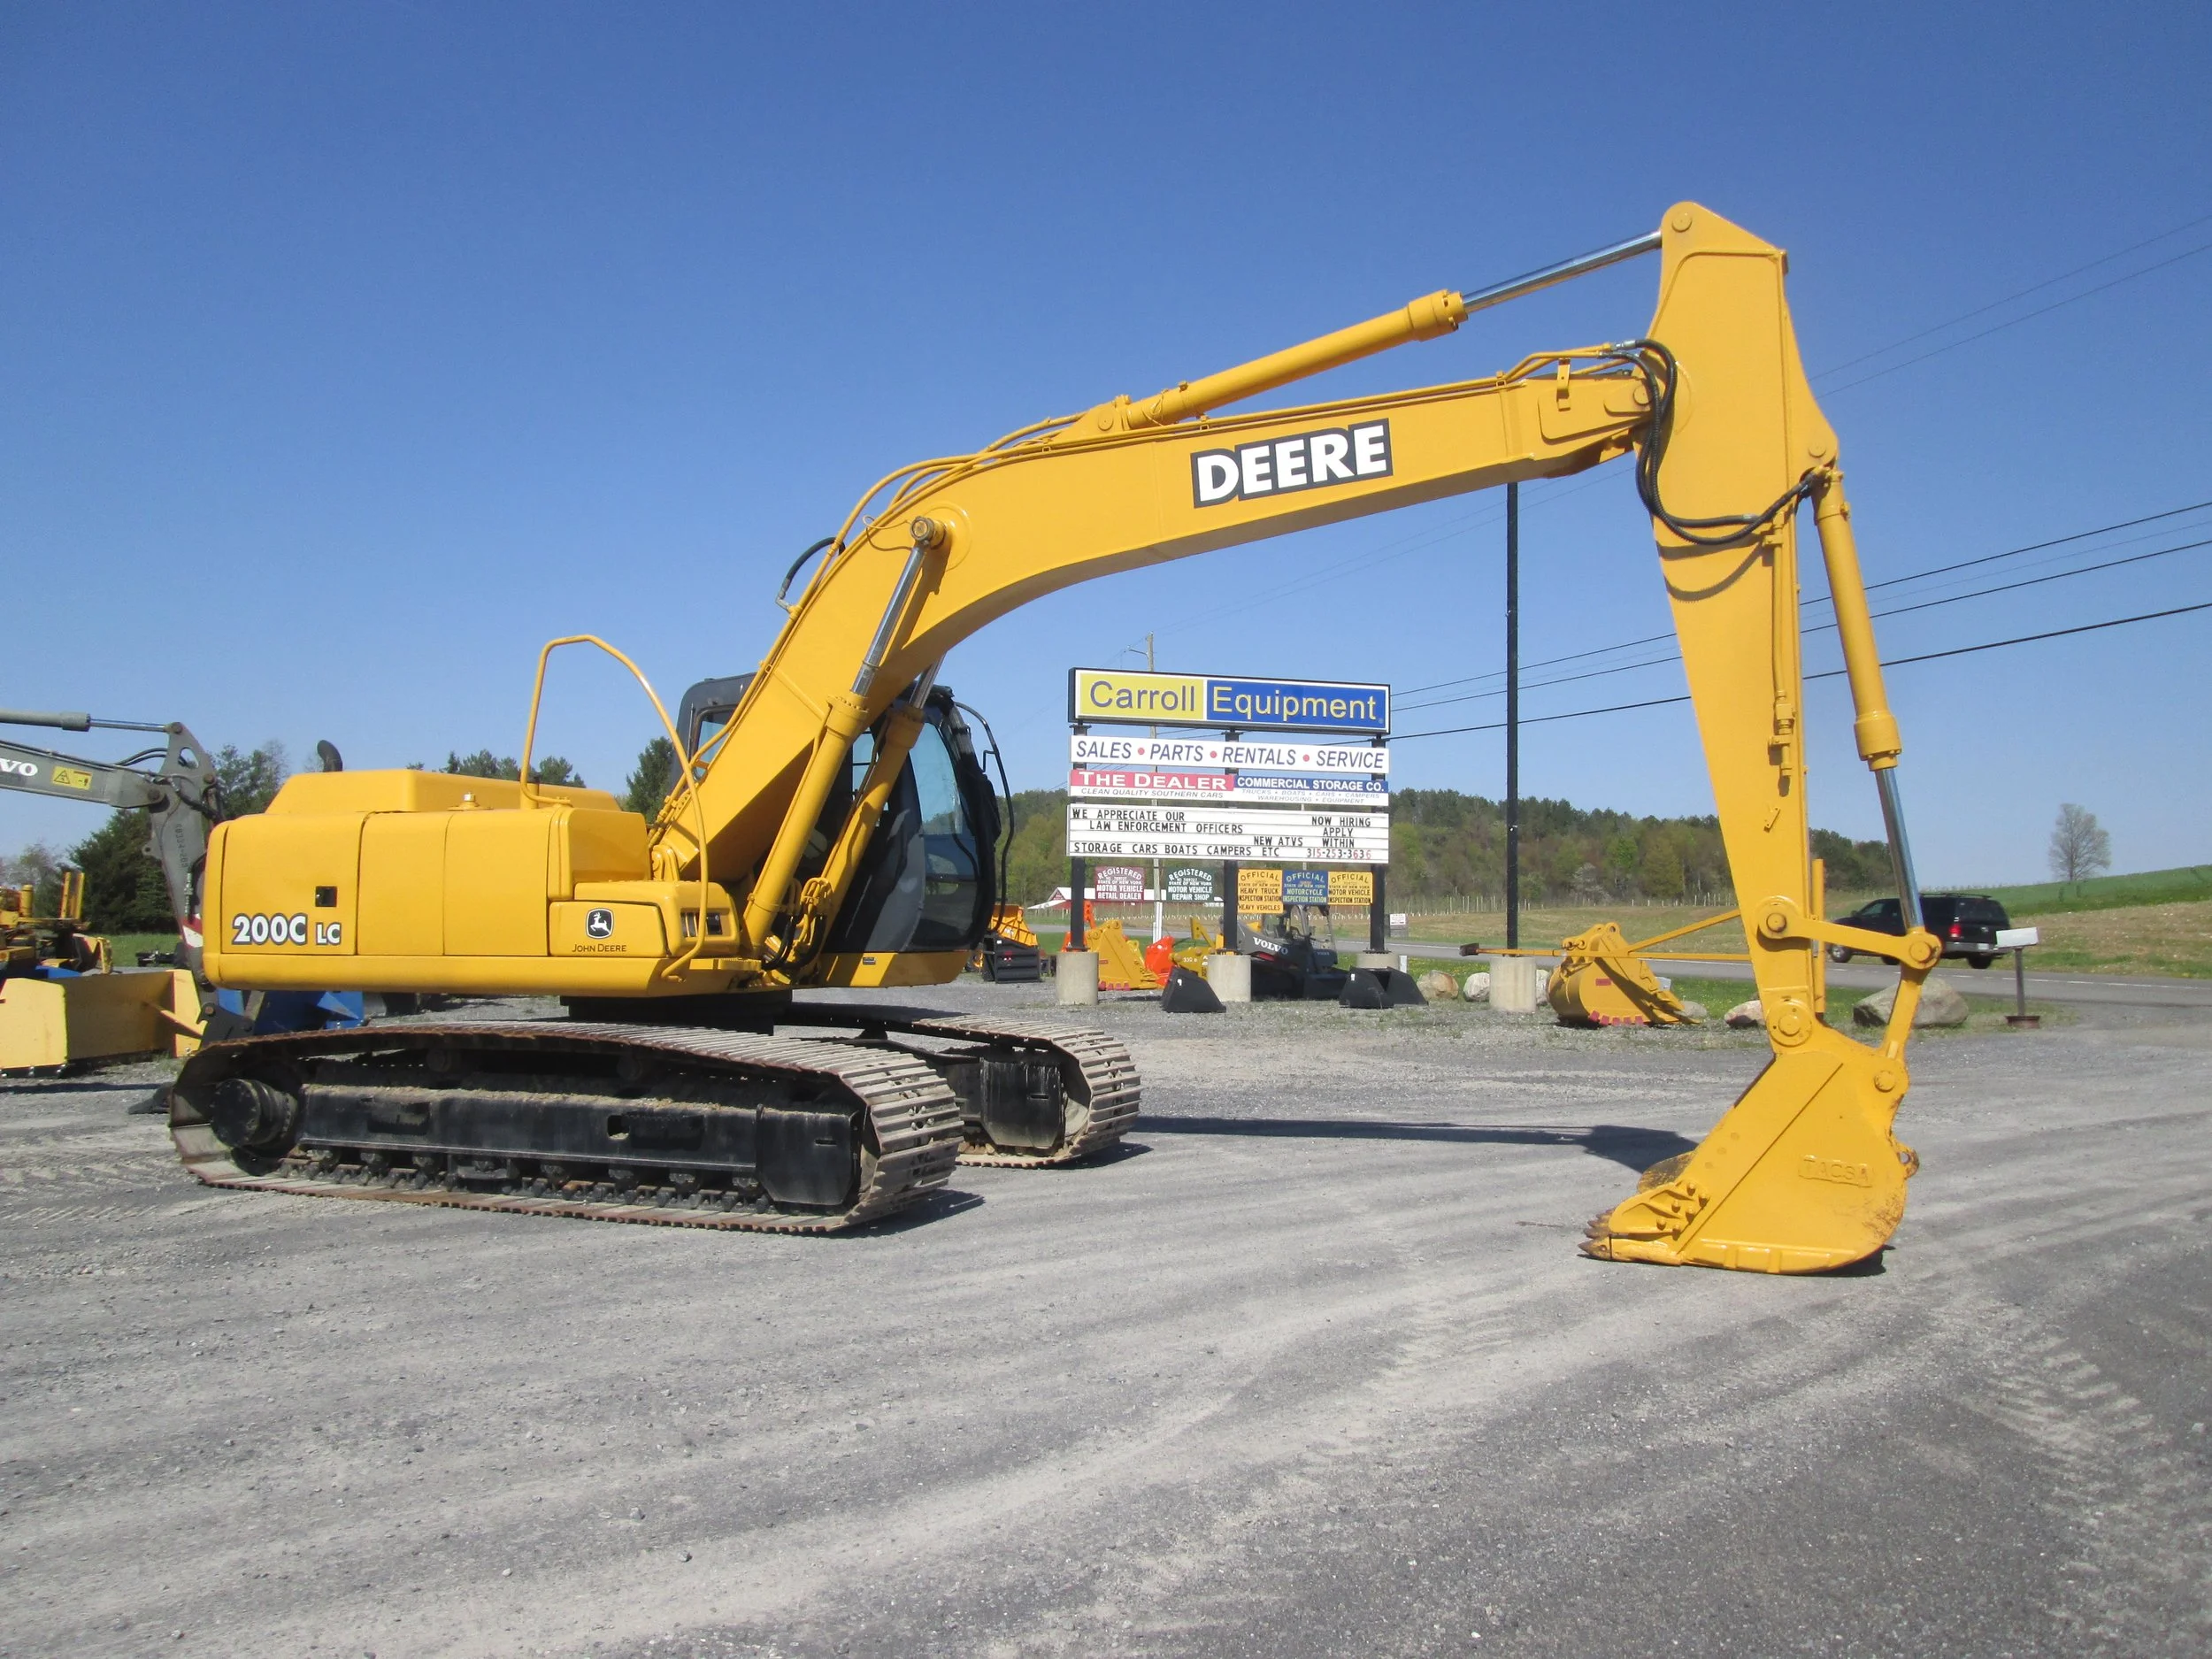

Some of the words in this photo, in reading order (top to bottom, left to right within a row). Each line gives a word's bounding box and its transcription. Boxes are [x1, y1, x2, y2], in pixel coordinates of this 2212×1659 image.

[1194, 421, 1389, 504] DEERE
[1089, 680, 1195, 711] Carroll
[1213, 687, 1377, 721] Equipment
[1076, 740, 1132, 759] SALES
[1149, 743, 1203, 761] PARTS
[1222, 747, 1296, 765] RENTALS
[1317, 750, 1385, 769] SERVICE
[1079, 771, 1126, 787] THE
[1134, 773, 1226, 790] DEALER
[1237, 777, 1310, 790] COMMERCIAL
[1313, 780, 1363, 791] STORAGE
[1366, 781, 1385, 792] CO.
[1072, 809, 1088, 819] WE
[1097, 810, 1157, 821] APPRECIATE
[1165, 811, 1185, 821] OUR
[1089, 821, 1111, 831] LAW
[1118, 821, 1187, 833] ENFORCEMENT
[1196, 824, 1243, 833] OFFICERS
[1311, 816, 1333, 826] NOW
[1340, 818, 1371, 827] HIRING
[1323, 827, 1354, 837] APPLY
[1254, 836, 1272, 846] NEW
[1279, 837, 1303, 847] ATVS
[1322, 838, 1355, 848] WITHIN
[1074, 842, 1122, 853] STORAGE
[1133, 843, 1157, 854] CARS
[1164, 844, 1198, 855] BOATS
[1207, 846, 1252, 856] CAMPERS
[1262, 848, 1280, 856] ETC
[1097, 867, 1142, 880] REGISTERED
[1168, 868, 1212, 881] REGISTERED
[1240, 872, 1279, 881] OFFICIAL
[1286, 872, 1325, 884] OFFICIAL
[1331, 873, 1369, 884] OFFICIAL
[233, 913, 308, 945] 200C
[316, 922, 342, 945] LC
[572, 943, 596, 953] JOHN
[597, 943, 627, 953] DEERE
[1253, 936, 1289, 955] VOLVO
